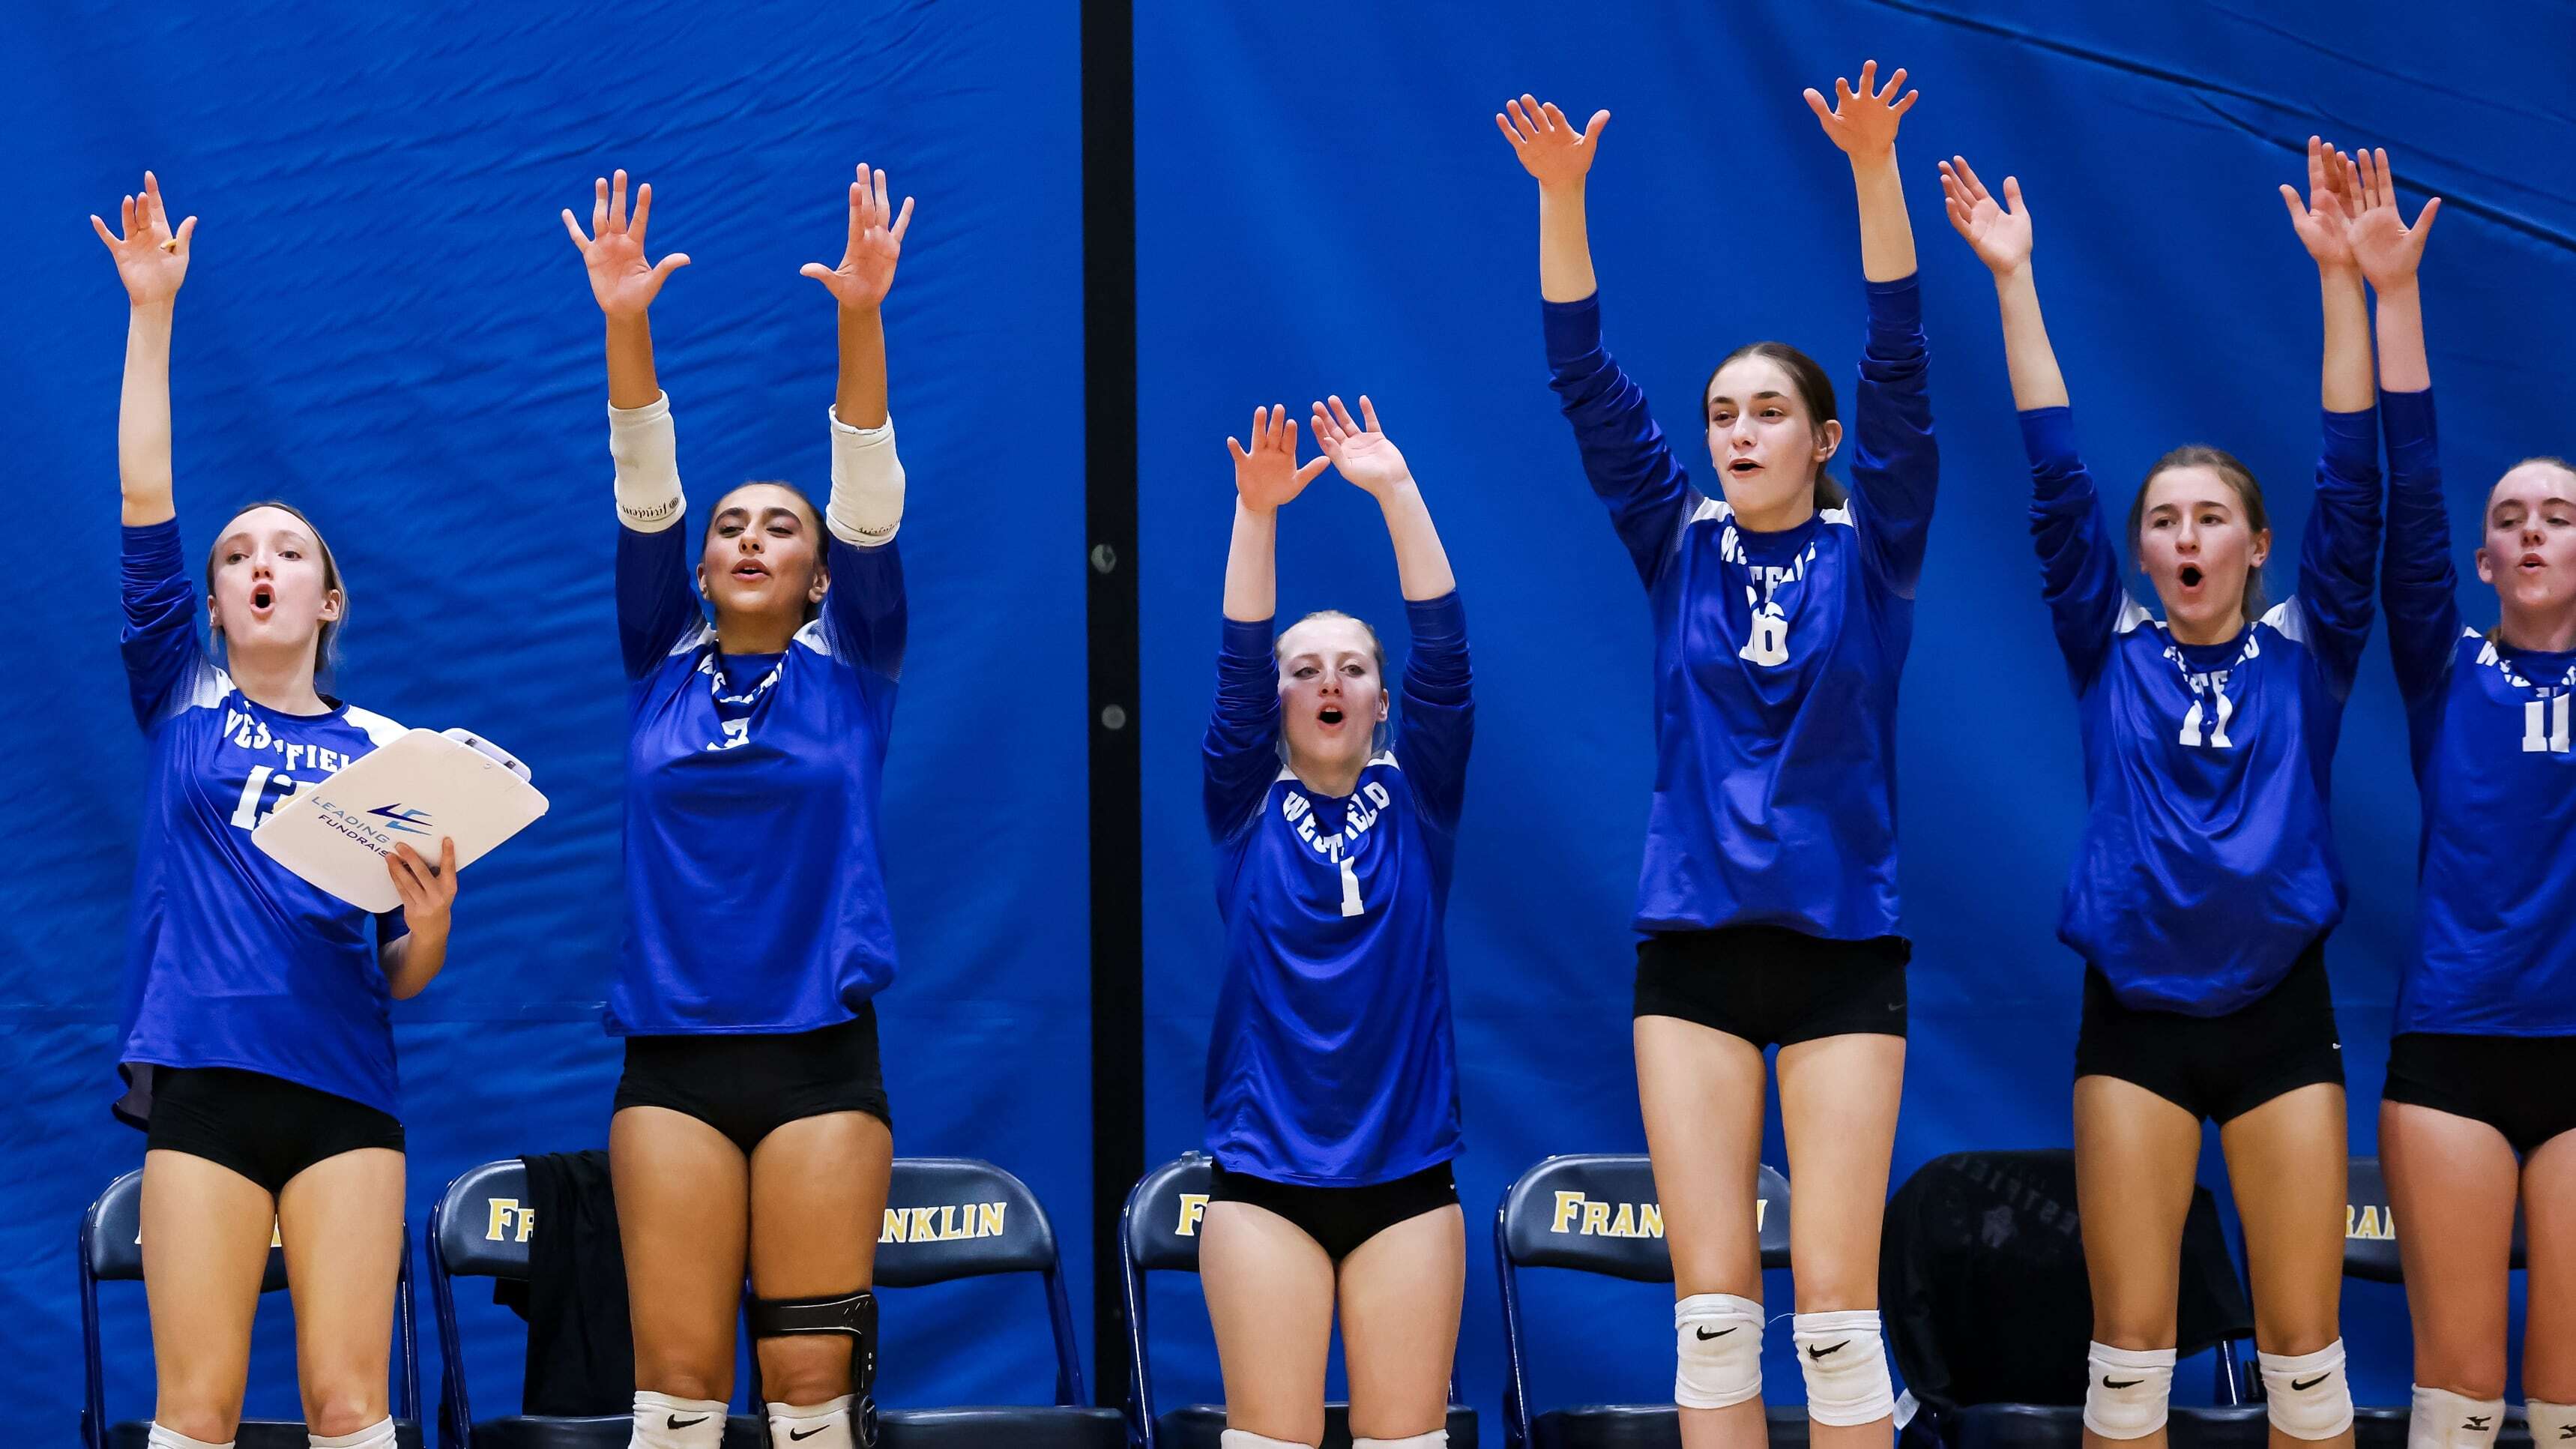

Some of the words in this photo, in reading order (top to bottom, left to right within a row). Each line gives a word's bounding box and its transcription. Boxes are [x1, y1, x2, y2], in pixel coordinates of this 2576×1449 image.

[2522, 693, 2570, 753] 11
[311, 796, 390, 843] LEADING
[318, 814, 389, 858] FUNDRAIS
[1282, 781, 1390, 864] WESTIELD
[1340, 855, 1365, 918] 1
[877, 1202, 1007, 1243] NKLIN
